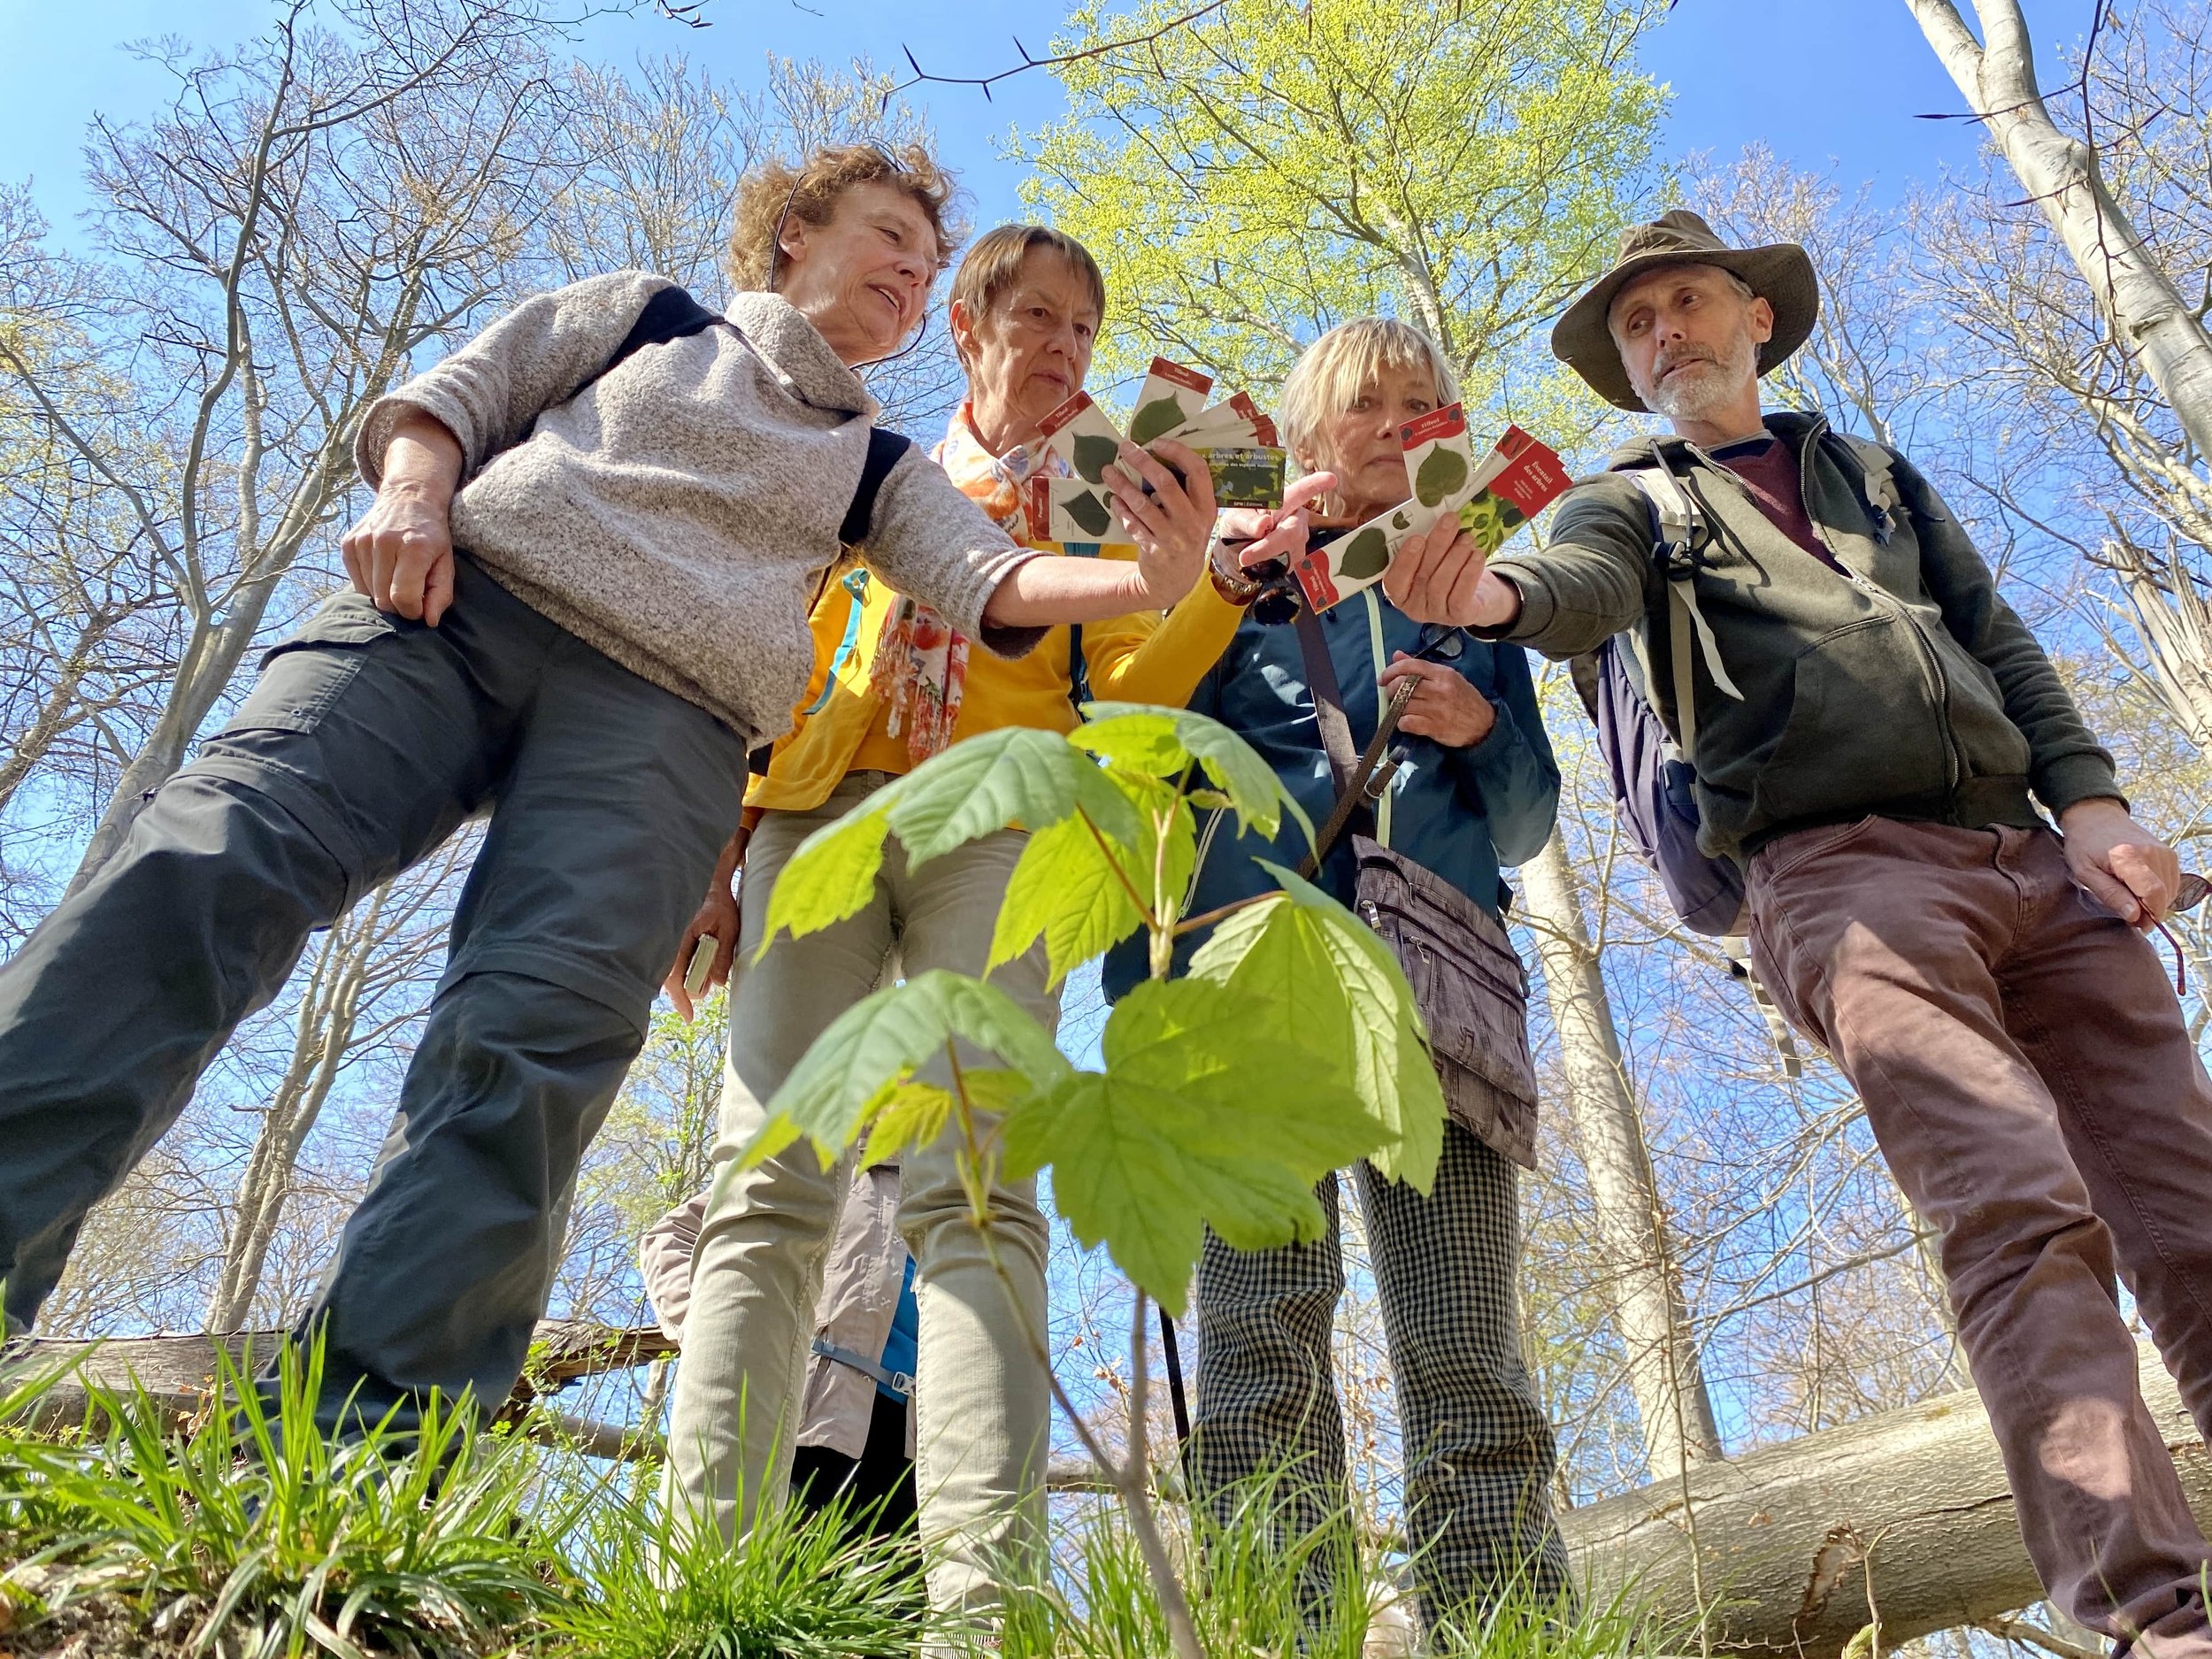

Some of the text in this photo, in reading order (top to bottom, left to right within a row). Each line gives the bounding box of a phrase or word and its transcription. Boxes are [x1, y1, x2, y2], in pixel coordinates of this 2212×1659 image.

[1524, 465, 1532, 476] des
[1531, 473, 1548, 493] arbres
[1531, 460, 1554, 484] Éventail
